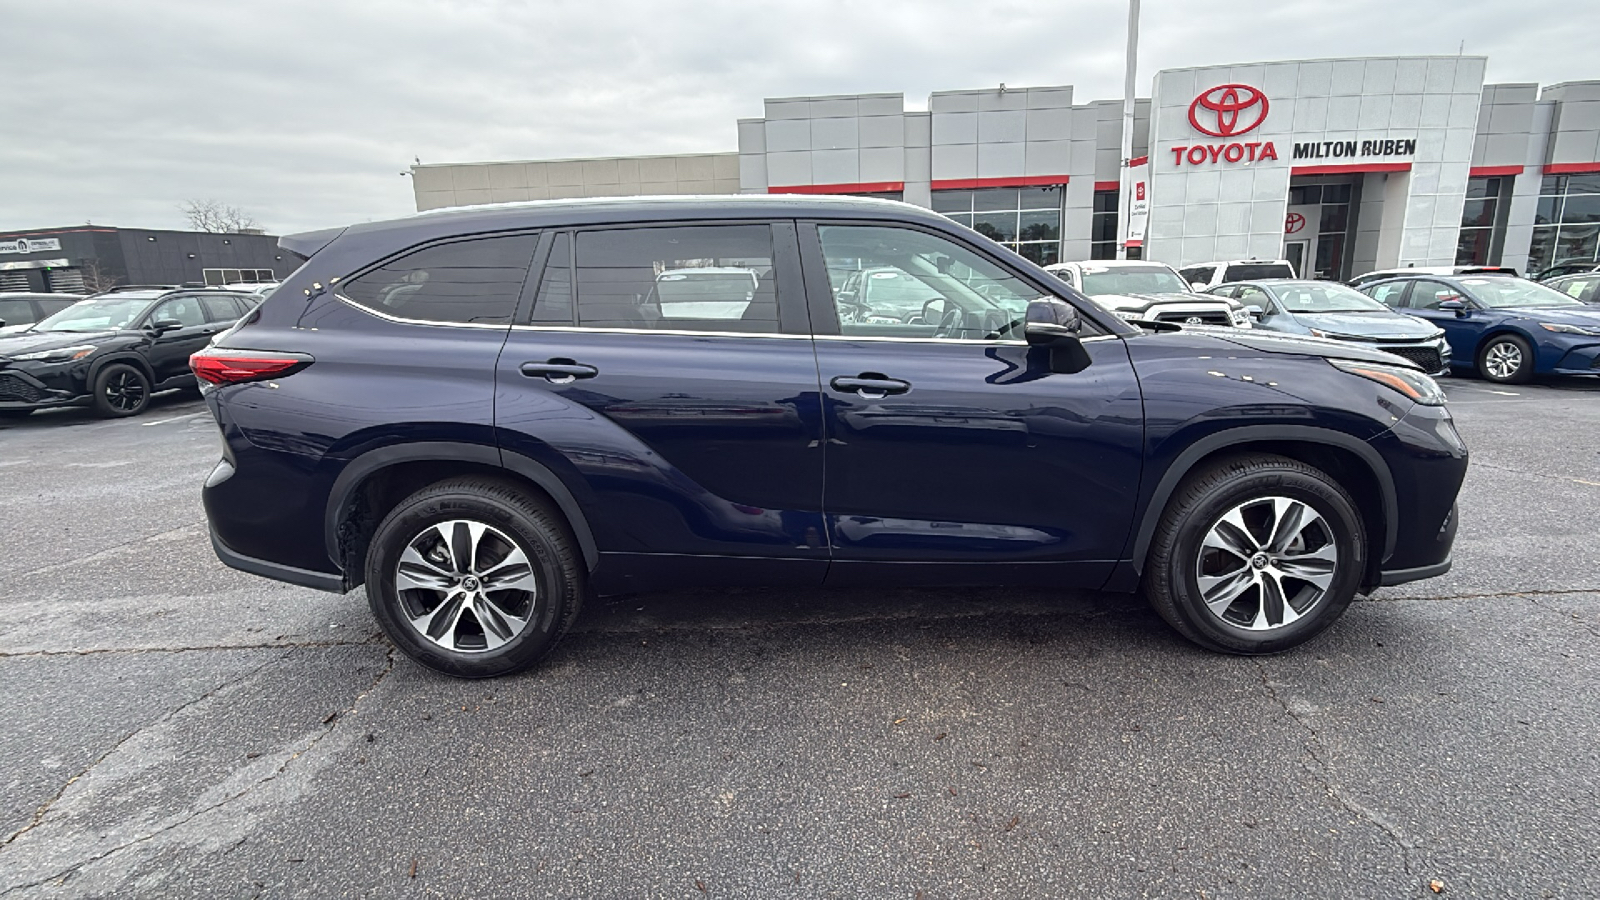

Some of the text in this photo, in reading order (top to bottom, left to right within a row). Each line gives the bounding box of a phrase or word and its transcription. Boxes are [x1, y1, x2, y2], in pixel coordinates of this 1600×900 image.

[1171, 141, 1278, 166] TOYOTA
[1293, 139, 1416, 159] MILTON RUBEN
